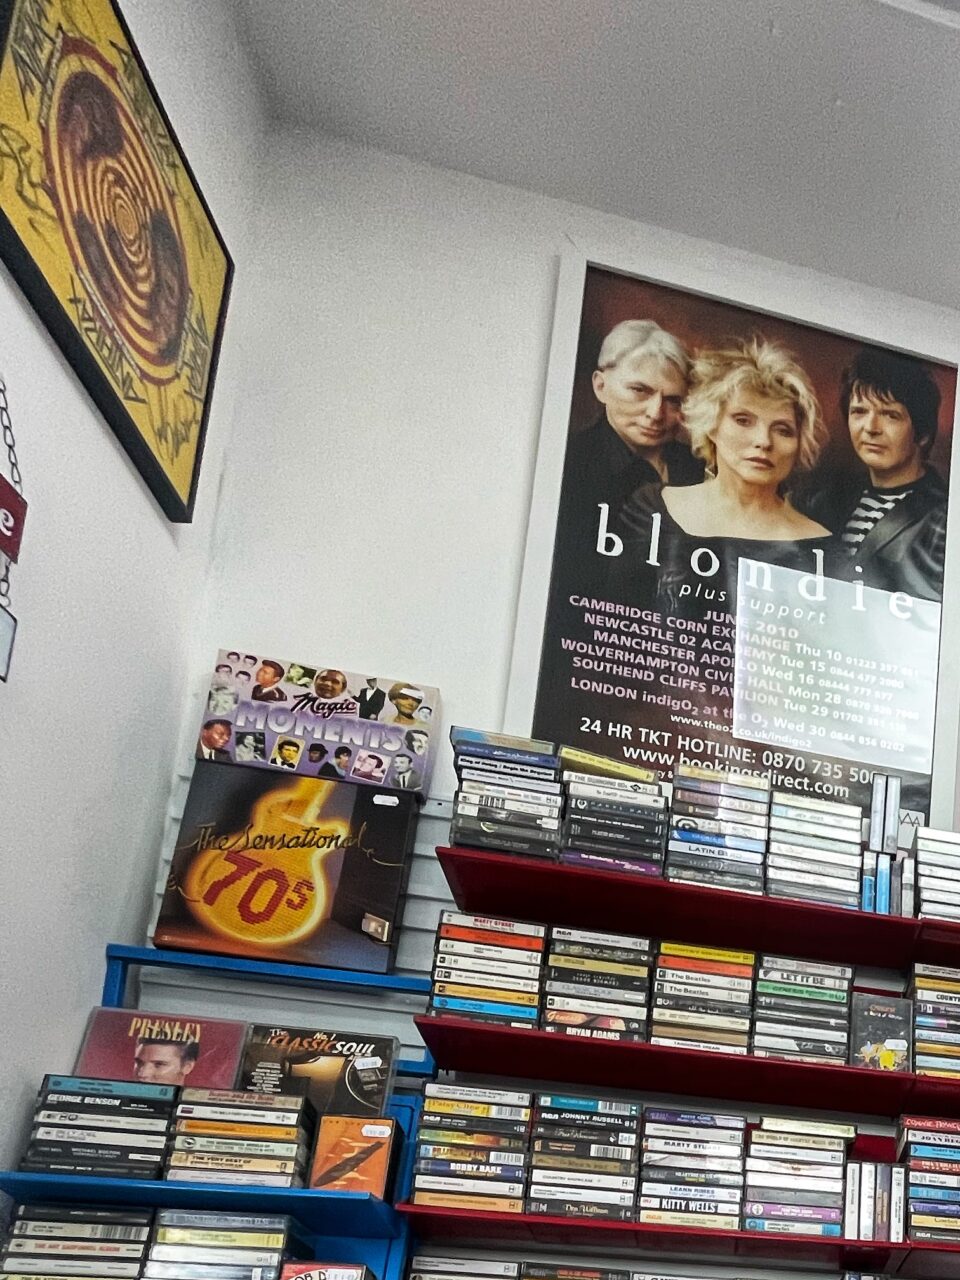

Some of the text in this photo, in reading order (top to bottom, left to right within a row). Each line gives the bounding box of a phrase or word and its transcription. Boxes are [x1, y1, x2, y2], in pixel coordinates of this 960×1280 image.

[596, 503, 914, 620] blondie
[678, 583, 826, 625] plus support
[569, 595, 842, 662] CAMBRIDGE CORN EXCHANGE Thu 10
[584, 613, 675, 642] NEWCASTLE
[701, 638, 776, 663] ACADEMY
[780, 654, 804, 668] Tue
[810, 660, 825, 672] 15
[703, 610, 799, 640] JUNE 2010
[561, 637, 841, 704] WOLVERHAMPTON CIVIC HALL Mon 28
[593, 630, 814, 685] MANCHESTER APOLLO Wed 16
[290, 692, 358, 718] Magic
[572, 656, 655, 682] SOUTHEND
[659, 674, 707, 693] CLIFFS
[711, 684, 779, 706] PAVILION
[783, 699, 806, 713] Tue
[811, 705, 828, 717] 29
[571, 677, 637, 700] LONDON
[702, 706, 718, 716] at
[722, 707, 748, 721] the
[773, 716, 804, 732] Wed
[809, 724, 826, 737] 30
[234, 702, 407, 752] MOMENTS
[580, 717, 602, 734] 24
[607, 722, 632, 740] HR
[638, 728, 672, 748] TKT
[677, 737, 757, 765] HOTLINE:
[762, 750, 806, 772] 0870
[811, 759, 843, 778] 735
[231, 820, 370, 853] Sensational
[202, 849, 316, 925] 70s
[684, 974, 711, 983] Beatles
[781, 973, 826, 985] LET IT BE
[127, 1016, 203, 1045] PRESLEY
[269, 1034, 376, 1056] CLASSIC SOUL
[566, 1027, 620, 1040] BRYAN ADAMS
[47, 1094, 121, 1106] GEORGE BENSON
[560, 1112, 623, 1125] JOHNNY RUSSELL
[662, 1199, 716, 1213] KITTY WELLS
